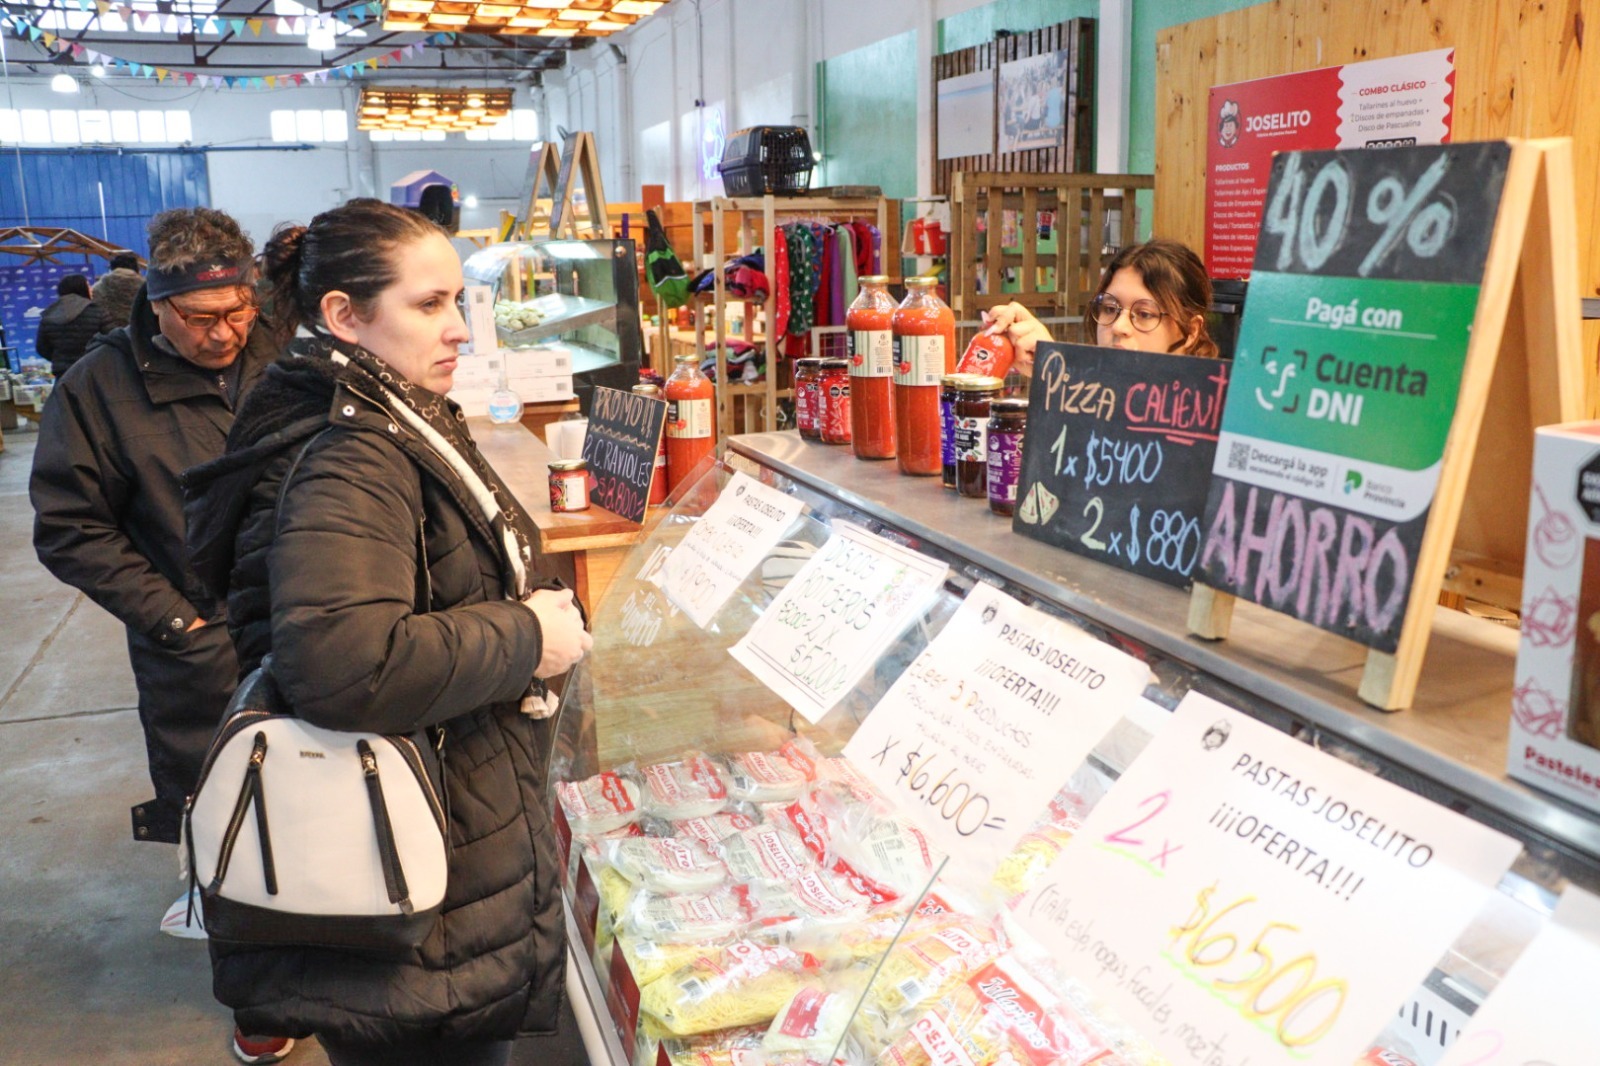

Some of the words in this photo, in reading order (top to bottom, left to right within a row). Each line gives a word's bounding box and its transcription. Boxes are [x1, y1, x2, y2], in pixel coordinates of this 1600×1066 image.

[1359, 85, 1389, 96] COMBO
[1391, 80, 1426, 92] CLÁSICO
[1245, 109, 1311, 133] JOSELITO
[1355, 114, 1375, 122] Discos
[1386, 109, 1424, 119] empanadas
[1359, 102, 1388, 111] Tallarines
[1377, 122, 1385, 130] de
[1386, 119, 1421, 129] Pascualina
[1215, 163, 1249, 172] PRODUCTOS
[1305, 297, 1359, 329] Pagá
[1361, 307, 1403, 330] con
[1316, 353, 1428, 397] Cuenta
[1306, 388, 1363, 426] DNI
[1251, 449, 1295, 470] Descargá
[1297, 459, 1306, 471] la
[1308, 464, 1328, 478] app
[1363, 491, 1406, 509] Provincia
[1366, 480, 1393, 495] Banco
[1201, 481, 1408, 634] AHORRO
[997, 623, 1045, 658] PASTAS
[1039, 647, 1106, 691] JOSELITO
[1232, 753, 1317, 808] PASTAS
[1313, 796, 1434, 869] JOSELITO
[763, 833, 791, 870] JOSELITO
[977, 975, 1050, 1048] Tallarines
